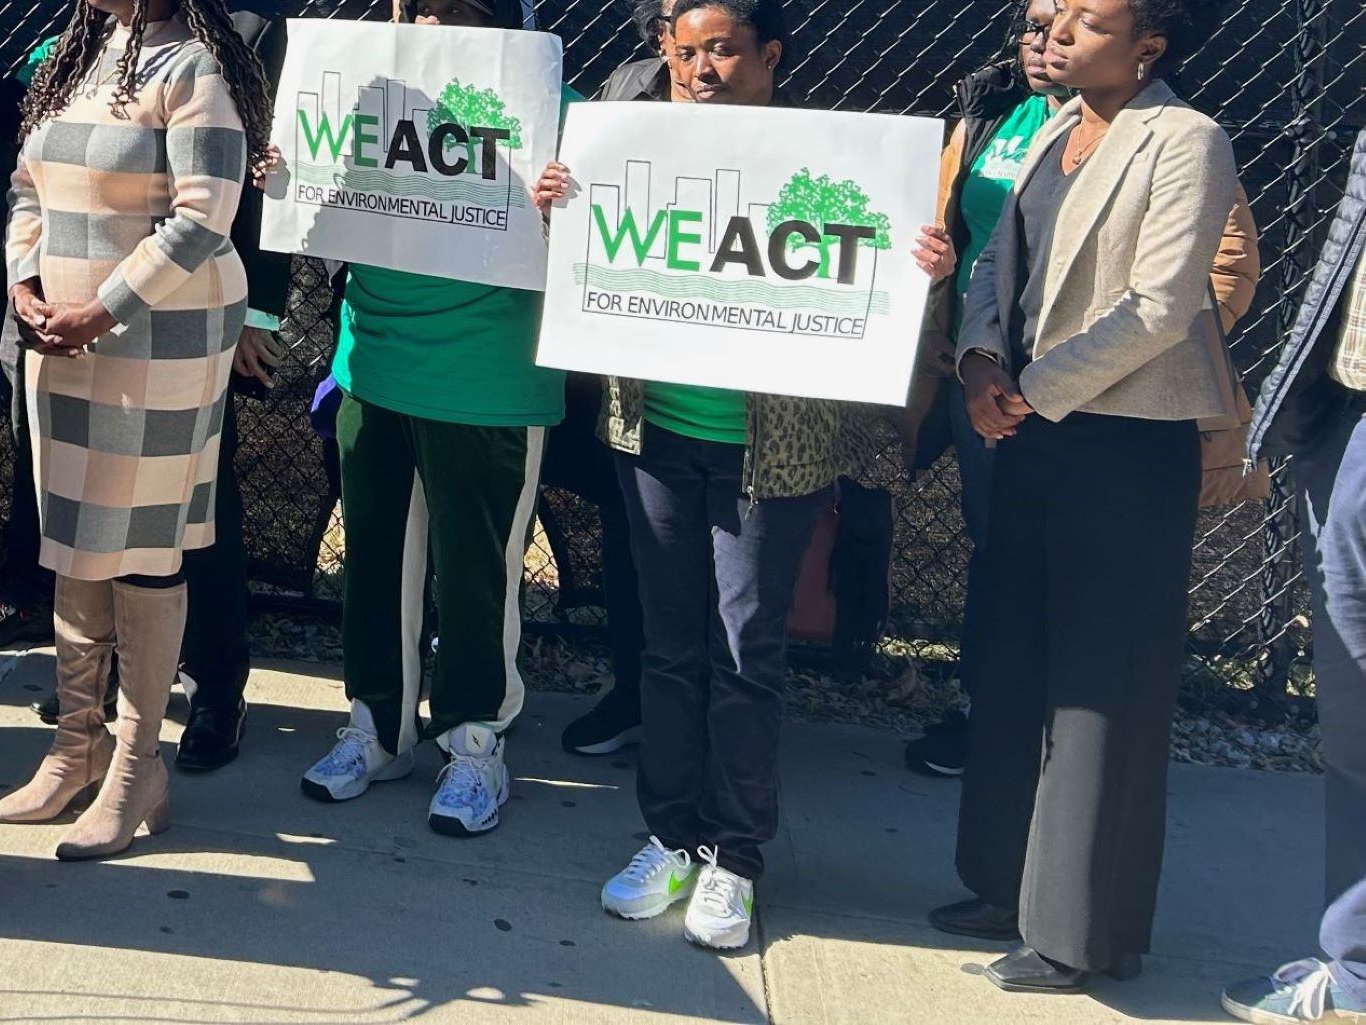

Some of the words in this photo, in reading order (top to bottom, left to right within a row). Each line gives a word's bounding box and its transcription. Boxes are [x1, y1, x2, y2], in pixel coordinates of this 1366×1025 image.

[297, 109, 379, 168] WE
[384, 119, 511, 181] ACT
[298, 184, 324, 203] FOR
[328, 187, 448, 220] ENVIRONMENTAL
[449, 205, 507, 227] JUSTICE
[591, 204, 703, 272] WE
[709, 215, 877, 285] ACT
[586, 291, 623, 312] FOR
[627, 295, 787, 330] ENVIRONMENTAL
[788, 312, 865, 335] JUSTICE
